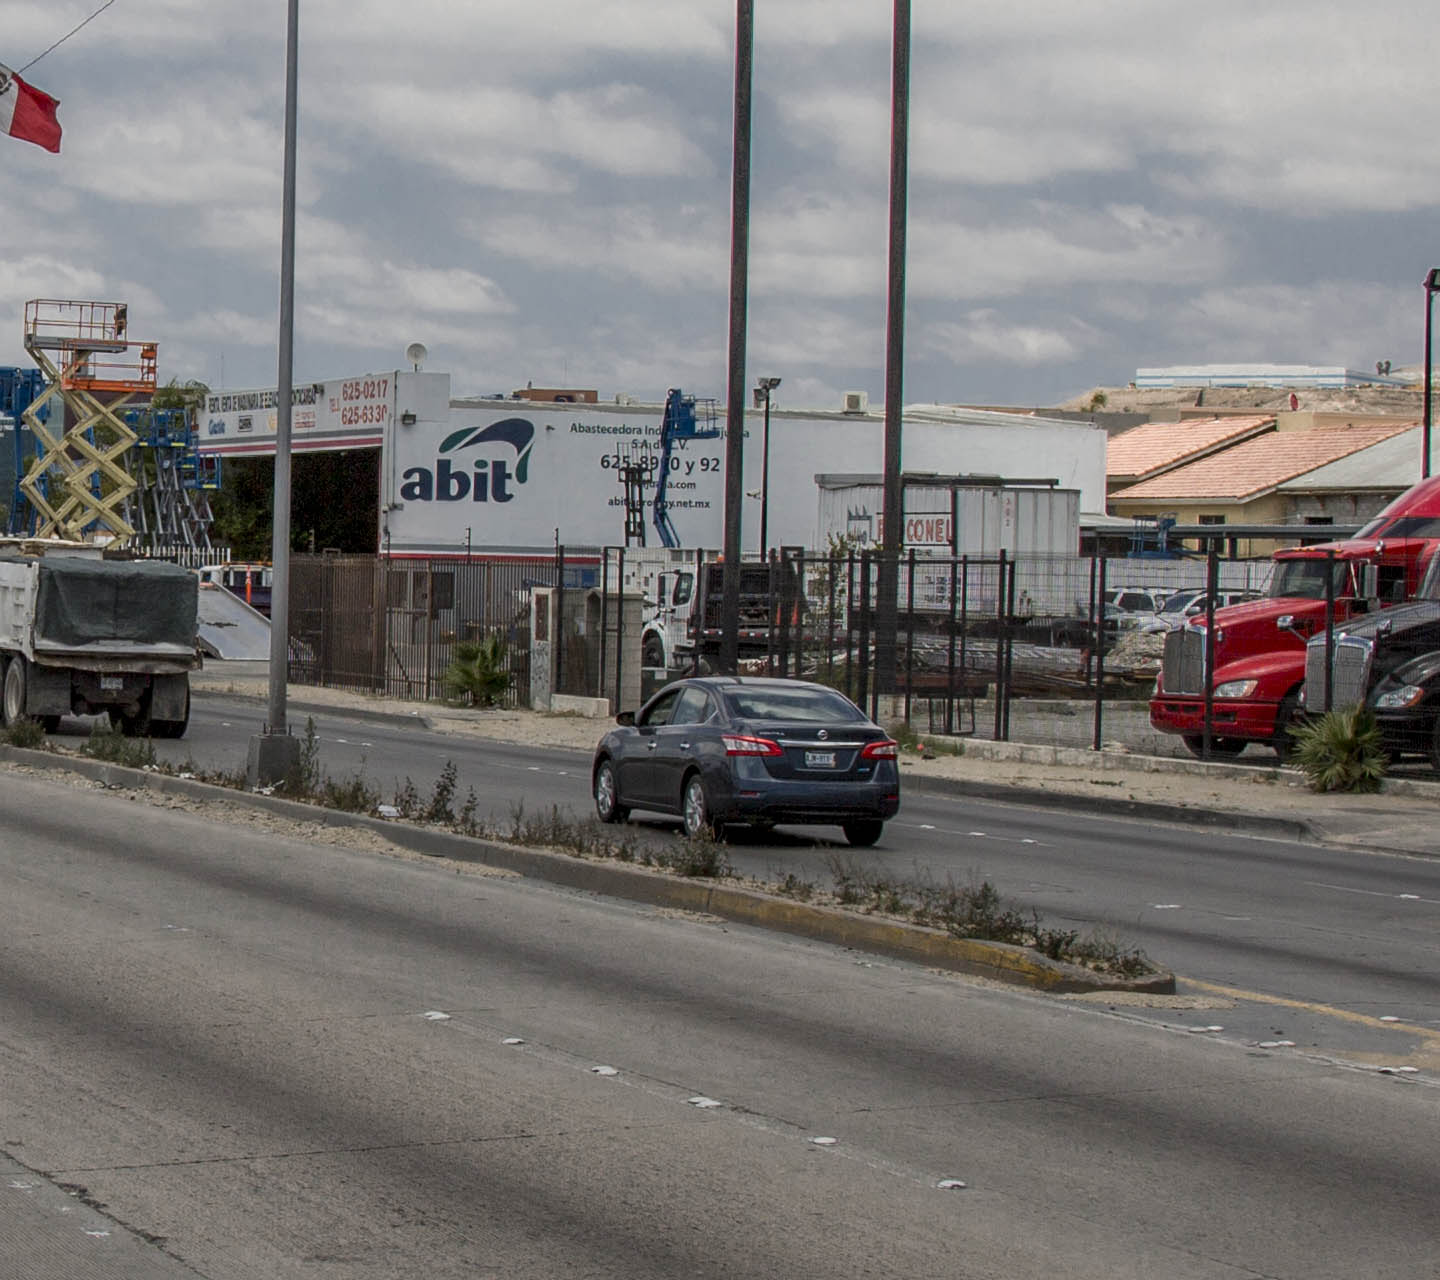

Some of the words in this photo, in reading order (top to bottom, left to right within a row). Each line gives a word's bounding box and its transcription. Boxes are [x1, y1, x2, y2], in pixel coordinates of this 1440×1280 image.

[342, 380, 388, 401] 625-0217
[570, 423, 642, 435] Abastecedora
[685, 461, 695, 476] y
[699, 457, 720, 472] 92
[400, 459, 517, 503] abit
